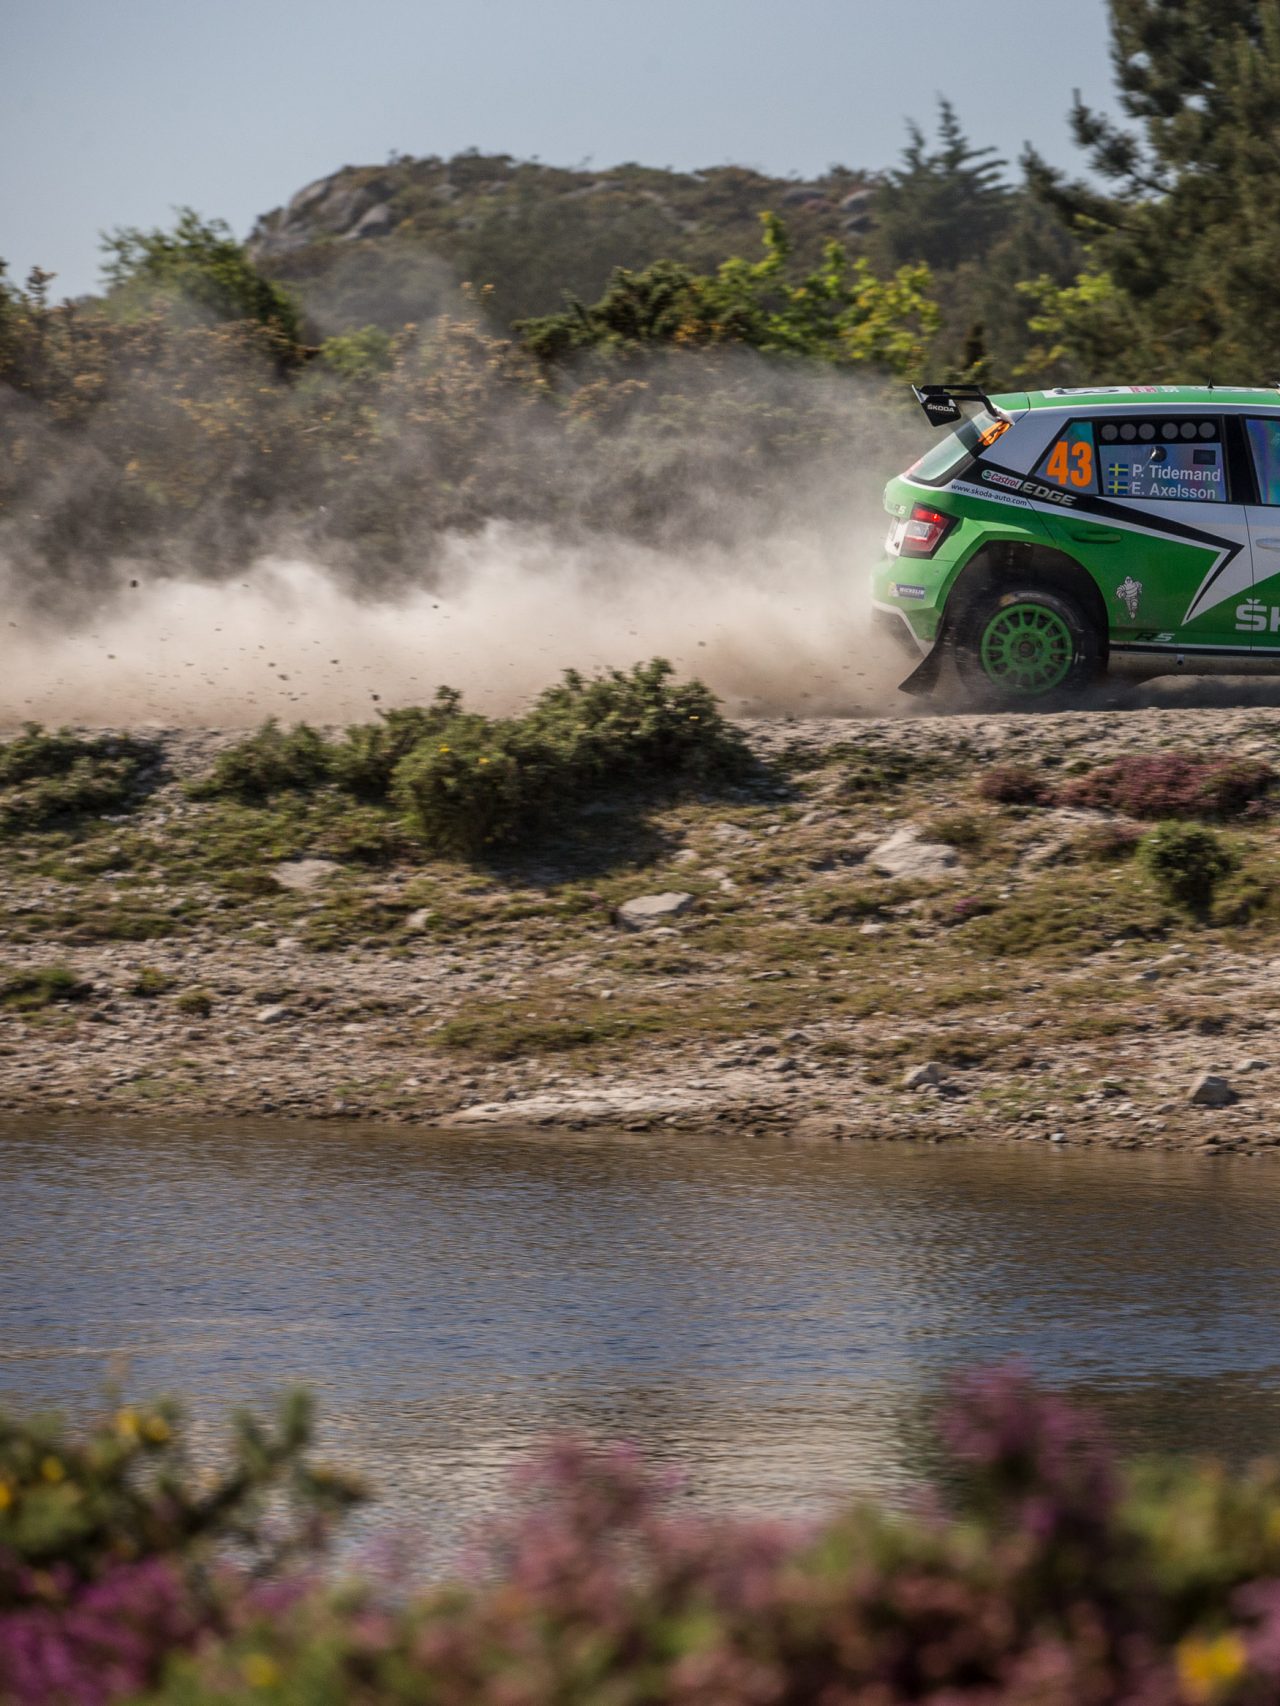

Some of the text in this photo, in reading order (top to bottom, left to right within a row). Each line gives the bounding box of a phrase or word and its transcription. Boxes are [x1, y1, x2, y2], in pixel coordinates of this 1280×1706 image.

[1046, 441, 1093, 487] 43
[1132, 464, 1221, 482] P. Tidemand
[951, 483, 1027, 506] www.skoda-auto.com
[990, 472, 1077, 506] Castrol EDGE
[1131, 482, 1216, 499] E. Axelsson
